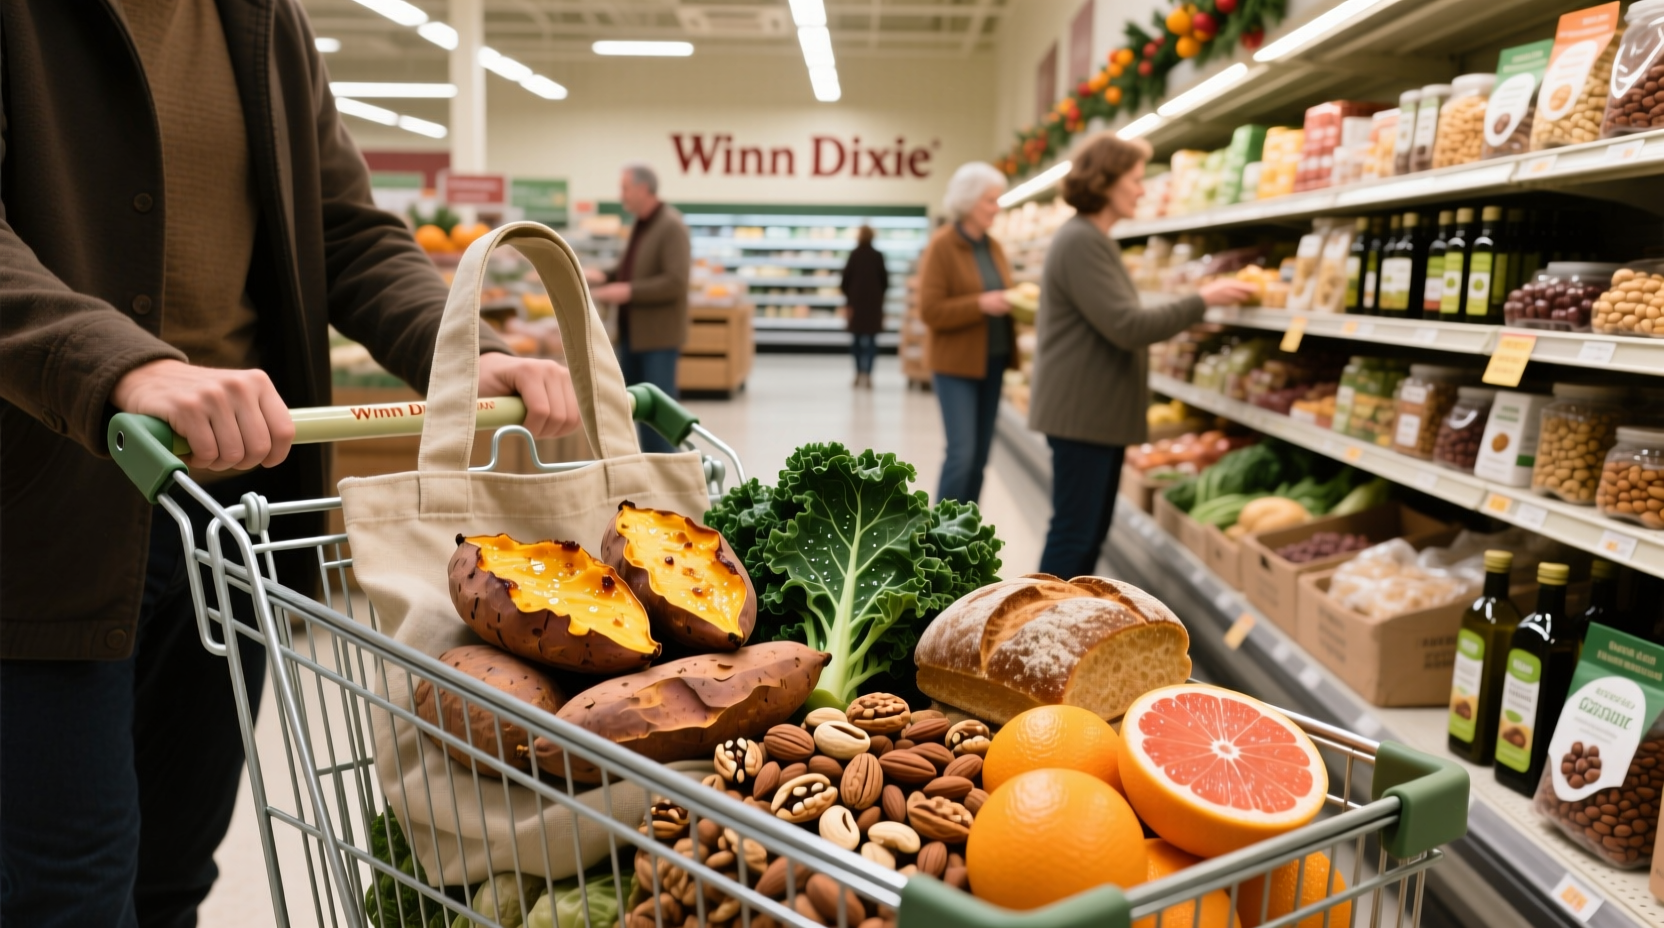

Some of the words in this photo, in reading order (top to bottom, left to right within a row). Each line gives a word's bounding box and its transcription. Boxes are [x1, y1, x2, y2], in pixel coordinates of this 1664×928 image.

[671, 134, 794, 176] Winn
[811, 136, 932, 178] Dixie
[350, 406, 403, 420] Winn
